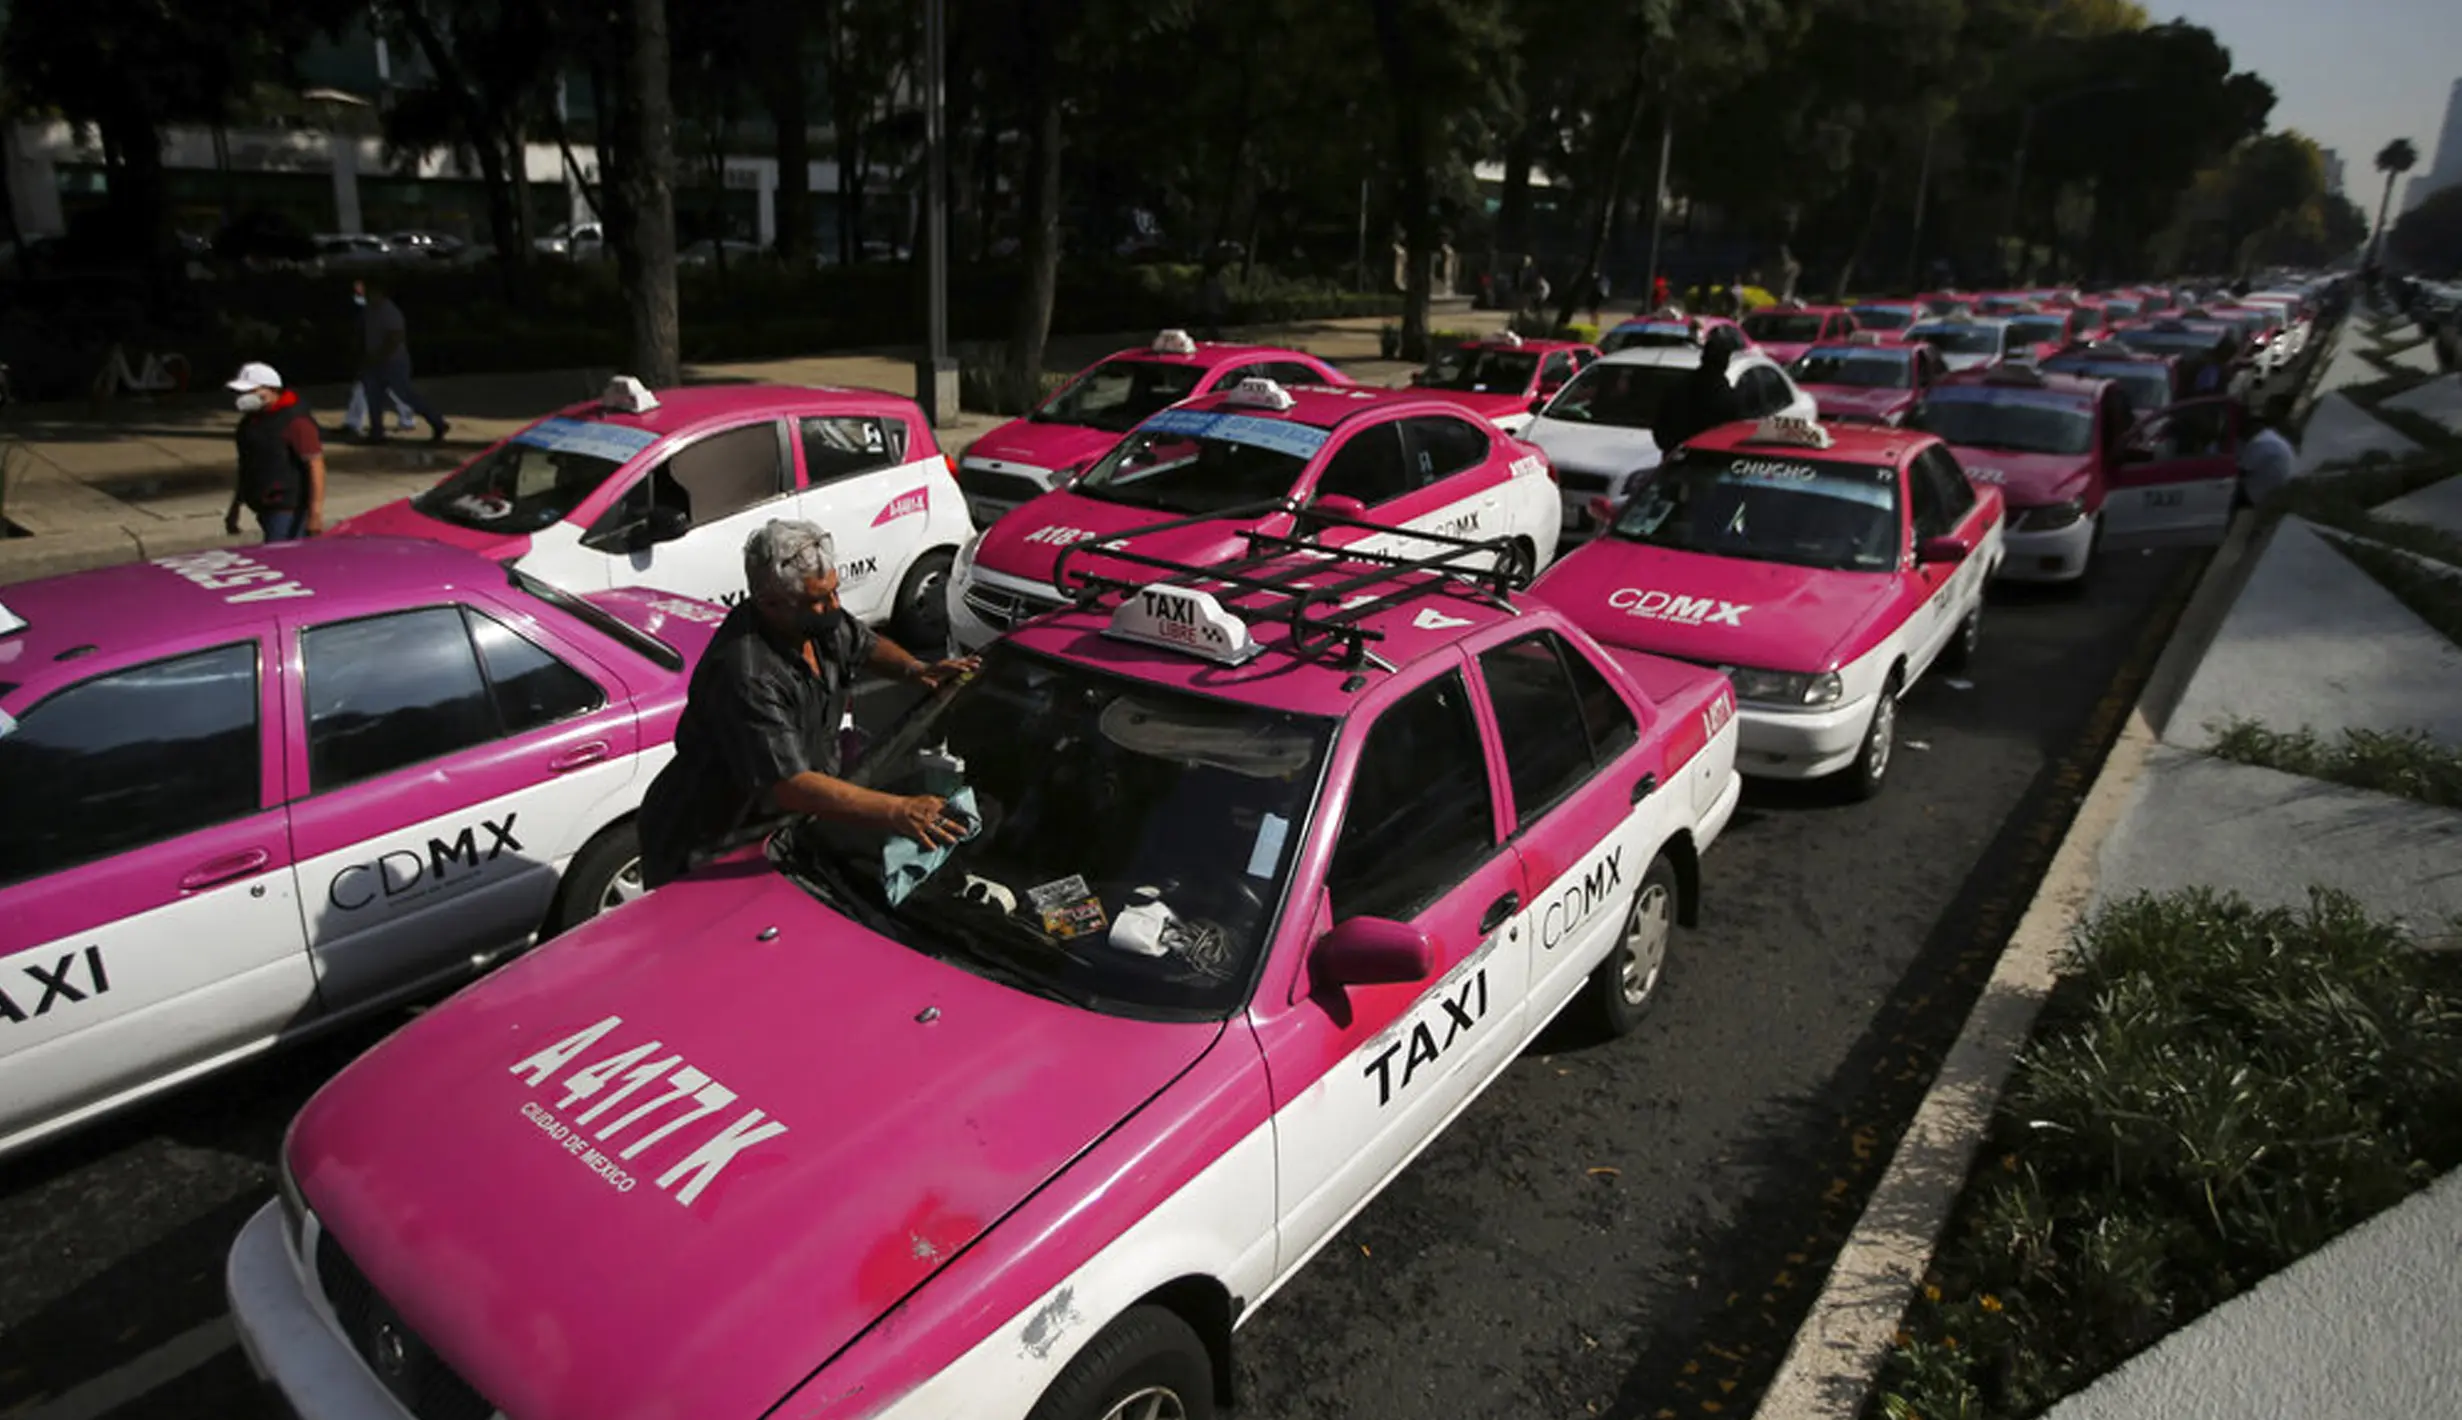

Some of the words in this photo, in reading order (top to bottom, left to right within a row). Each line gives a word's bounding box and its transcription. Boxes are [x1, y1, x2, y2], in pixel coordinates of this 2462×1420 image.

[1730, 459, 1817, 481] CHUCHO
[838, 556, 878, 580] DMX
[1142, 590, 1195, 625] TAXI
[1608, 587, 1752, 627] CDMX
[1158, 619, 1197, 645] LIBRE
[329, 812, 525, 911] CDMX
[1542, 844, 1622, 950] CDMX
[1363, 968, 1488, 1108] TAXI
[520, 1101, 570, 1141] CIUDAD
[561, 1134, 590, 1156] DE
[579, 1148, 637, 1193] MEXICO
